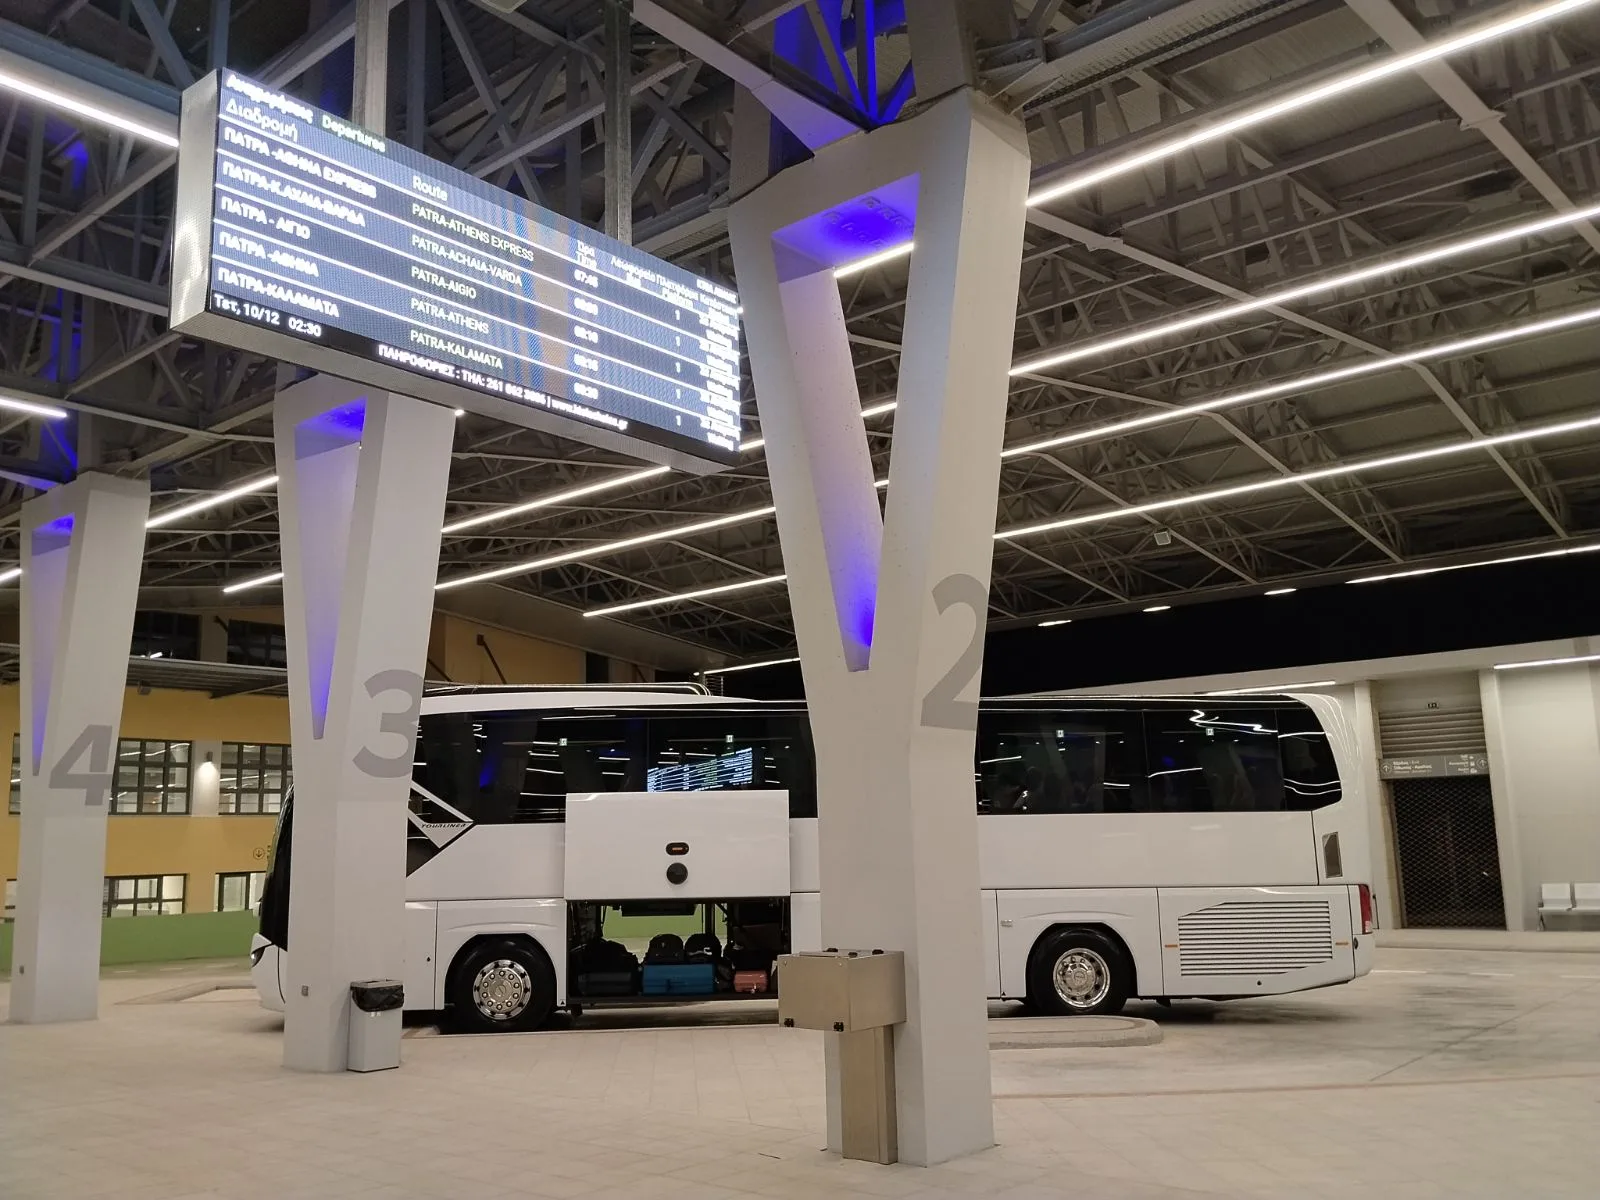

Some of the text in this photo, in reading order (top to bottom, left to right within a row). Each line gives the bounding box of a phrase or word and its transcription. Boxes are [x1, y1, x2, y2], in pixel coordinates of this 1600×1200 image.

[226, 98, 298, 143] Διαδρομή
[322, 114, 385, 152] Departures
[224, 127, 270, 156] ΠΑΤΡΑ
[412, 175, 448, 201] Route
[221, 196, 267, 225] ΠΑΤΡΑ
[219, 232, 266, 259] ΠΑΤΡΑ
[412, 203, 534, 261] PATRA-ATHENS EXPRESS
[412, 234, 523, 287] PATRA-ACHAIA-VARDA
[218, 267, 340, 318] ΠΑΤΡΑ-ΚΑΛΑΜΑΤΑ
[411, 266, 477, 299] PATRA-AIGIO
[214, 294, 322, 337] Τετ, 10/12 02:30
[411, 298, 489, 334] PATRA-ATHENS
[410, 330, 503, 370] PATRA-KALAMATA
[676, 415, 681, 426] 1
[920, 573, 989, 731] 2
[352, 669, 424, 778] 3
[49, 724, 113, 806] 4
